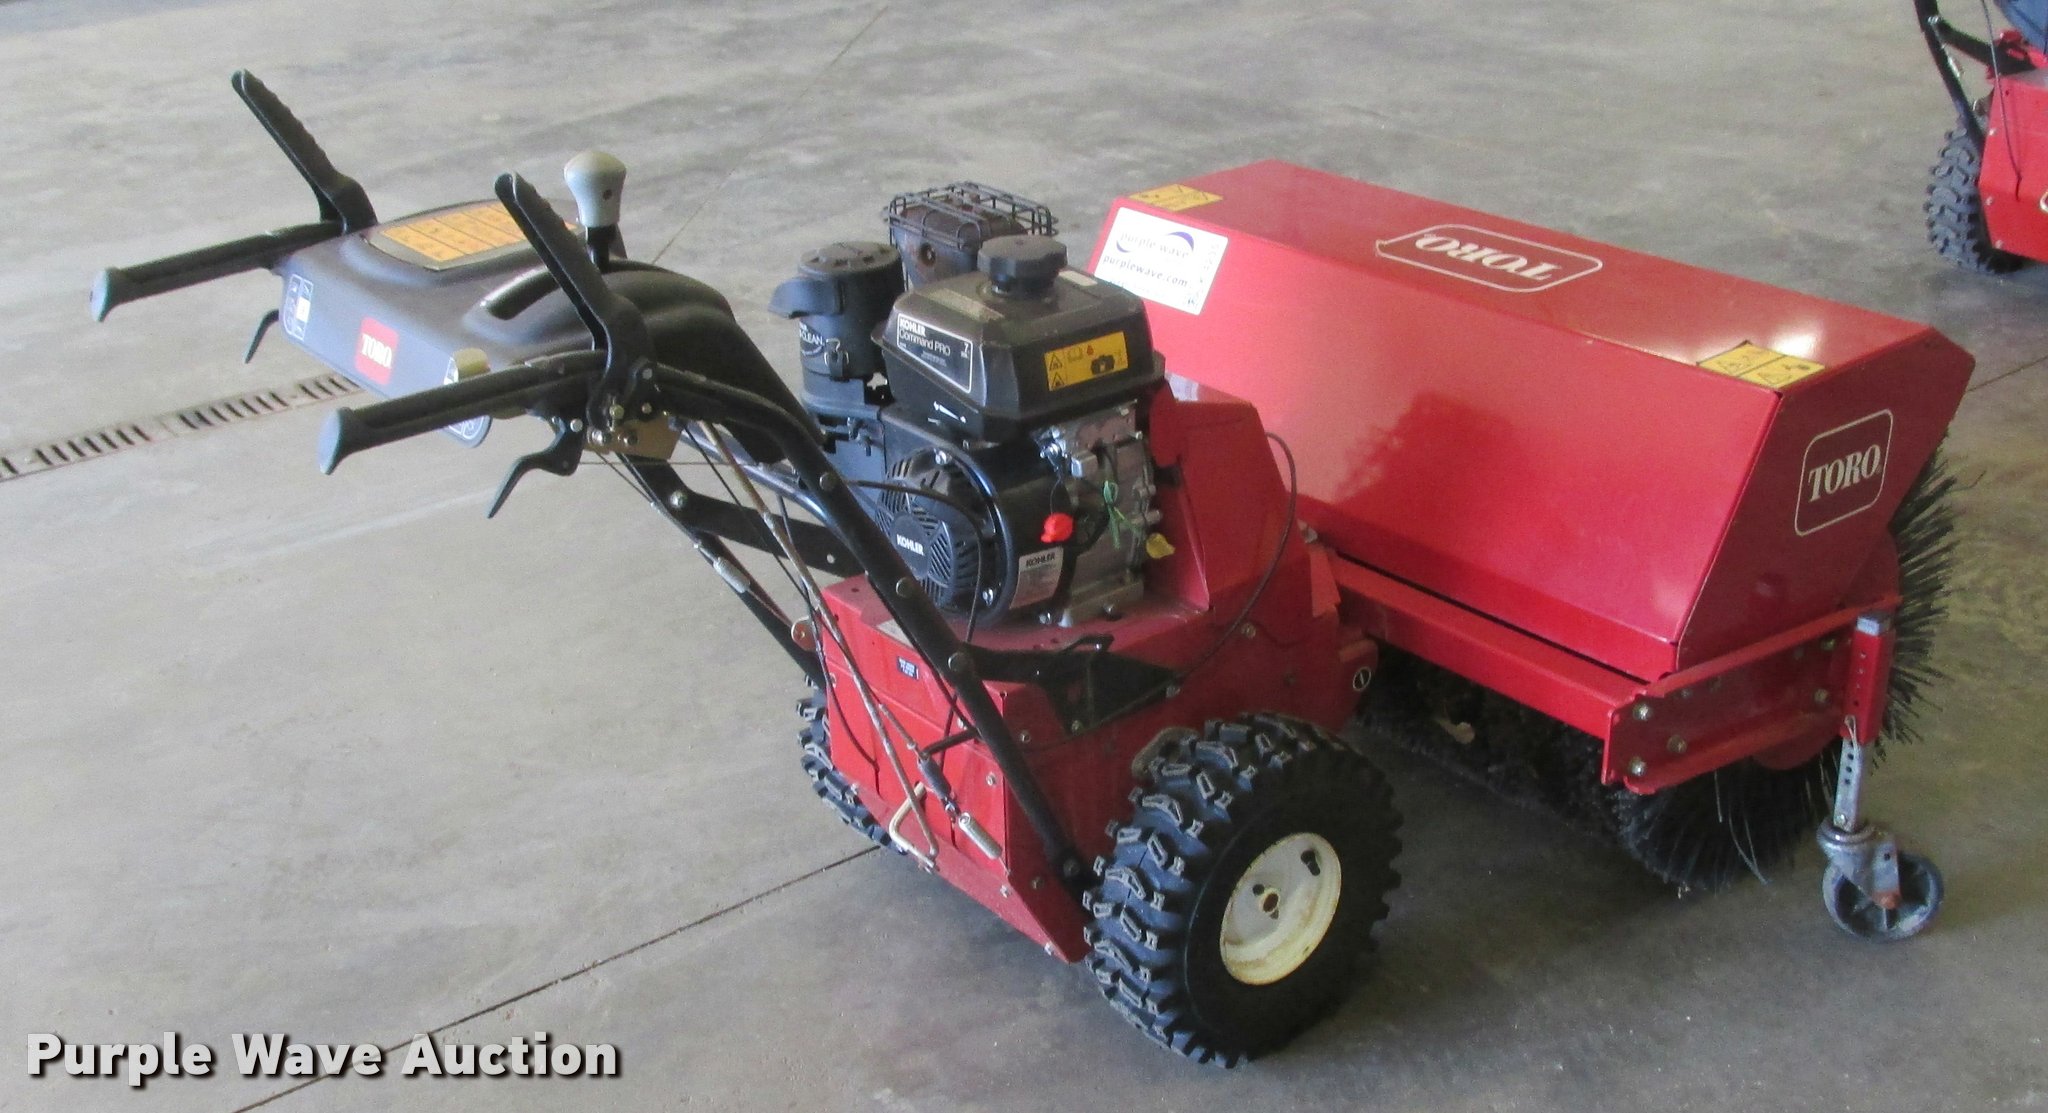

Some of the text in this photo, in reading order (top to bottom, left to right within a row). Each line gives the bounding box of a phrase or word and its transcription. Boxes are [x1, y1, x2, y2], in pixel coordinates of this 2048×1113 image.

[1120, 231, 1189, 259] purple wave
[1415, 236, 1562, 281] TORO
[1103, 254, 1188, 287] purplewave.com
[900, 318, 926, 338] KOHLER
[362, 333, 392, 368] TORO
[899, 329, 934, 351] Command
[934, 341, 951, 357] PRO
[1808, 444, 1882, 502] TORO
[896, 533, 924, 556] KOHLER
[1025, 552, 1056, 567] KOHLER
